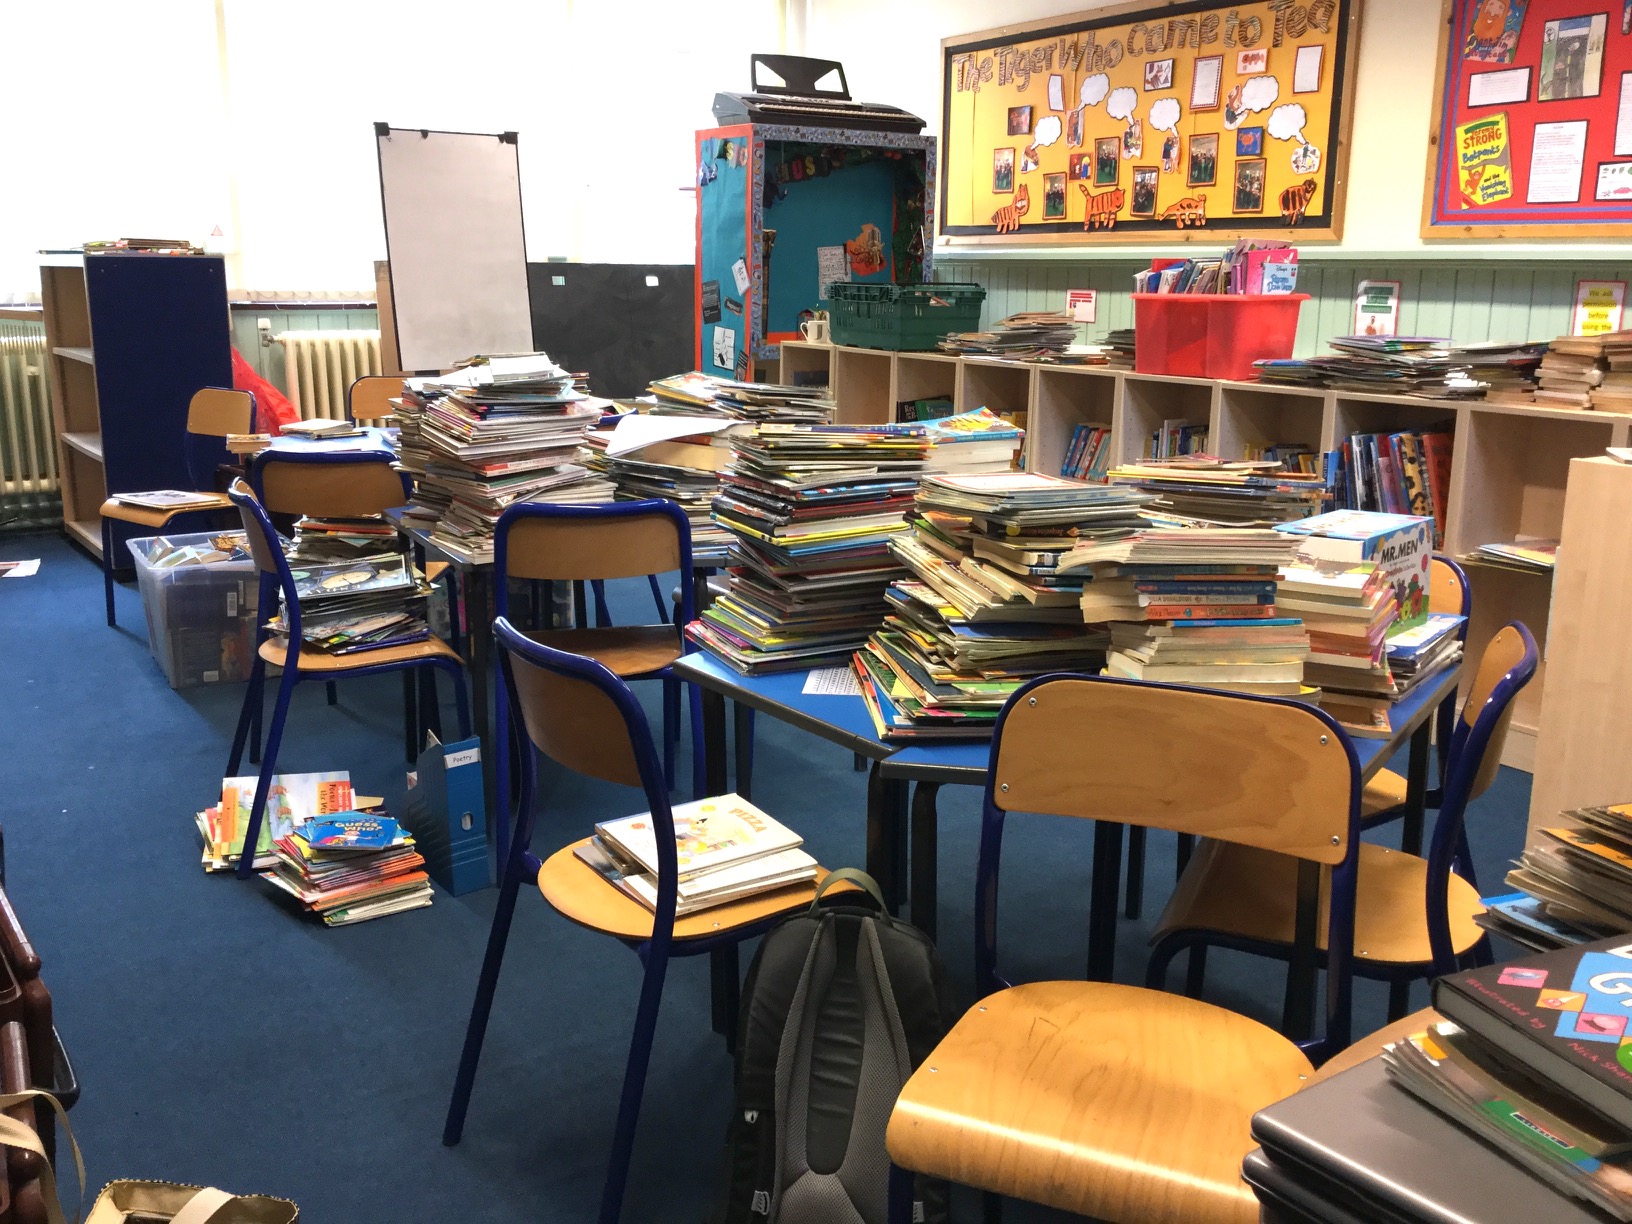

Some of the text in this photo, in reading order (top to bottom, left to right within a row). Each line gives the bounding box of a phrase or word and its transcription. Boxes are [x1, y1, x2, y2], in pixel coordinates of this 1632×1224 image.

[952, 53, 993, 93] The
[993, 42, 1058, 93] Tiger
[1059, 30, 1123, 72] Who
[1223, 9, 1263, 48] to
[1267, 0, 1336, 48] Tea
[1463, 127, 1502, 150] STRONG
[1602, 323, 1612, 331] the
[452, 755, 473, 763] Poetry
[728, 808, 767, 833] PIZZA
[1466, 978, 1547, 1030] Illustrated by
[1568, 1041, 1632, 1084] Nick Shar
